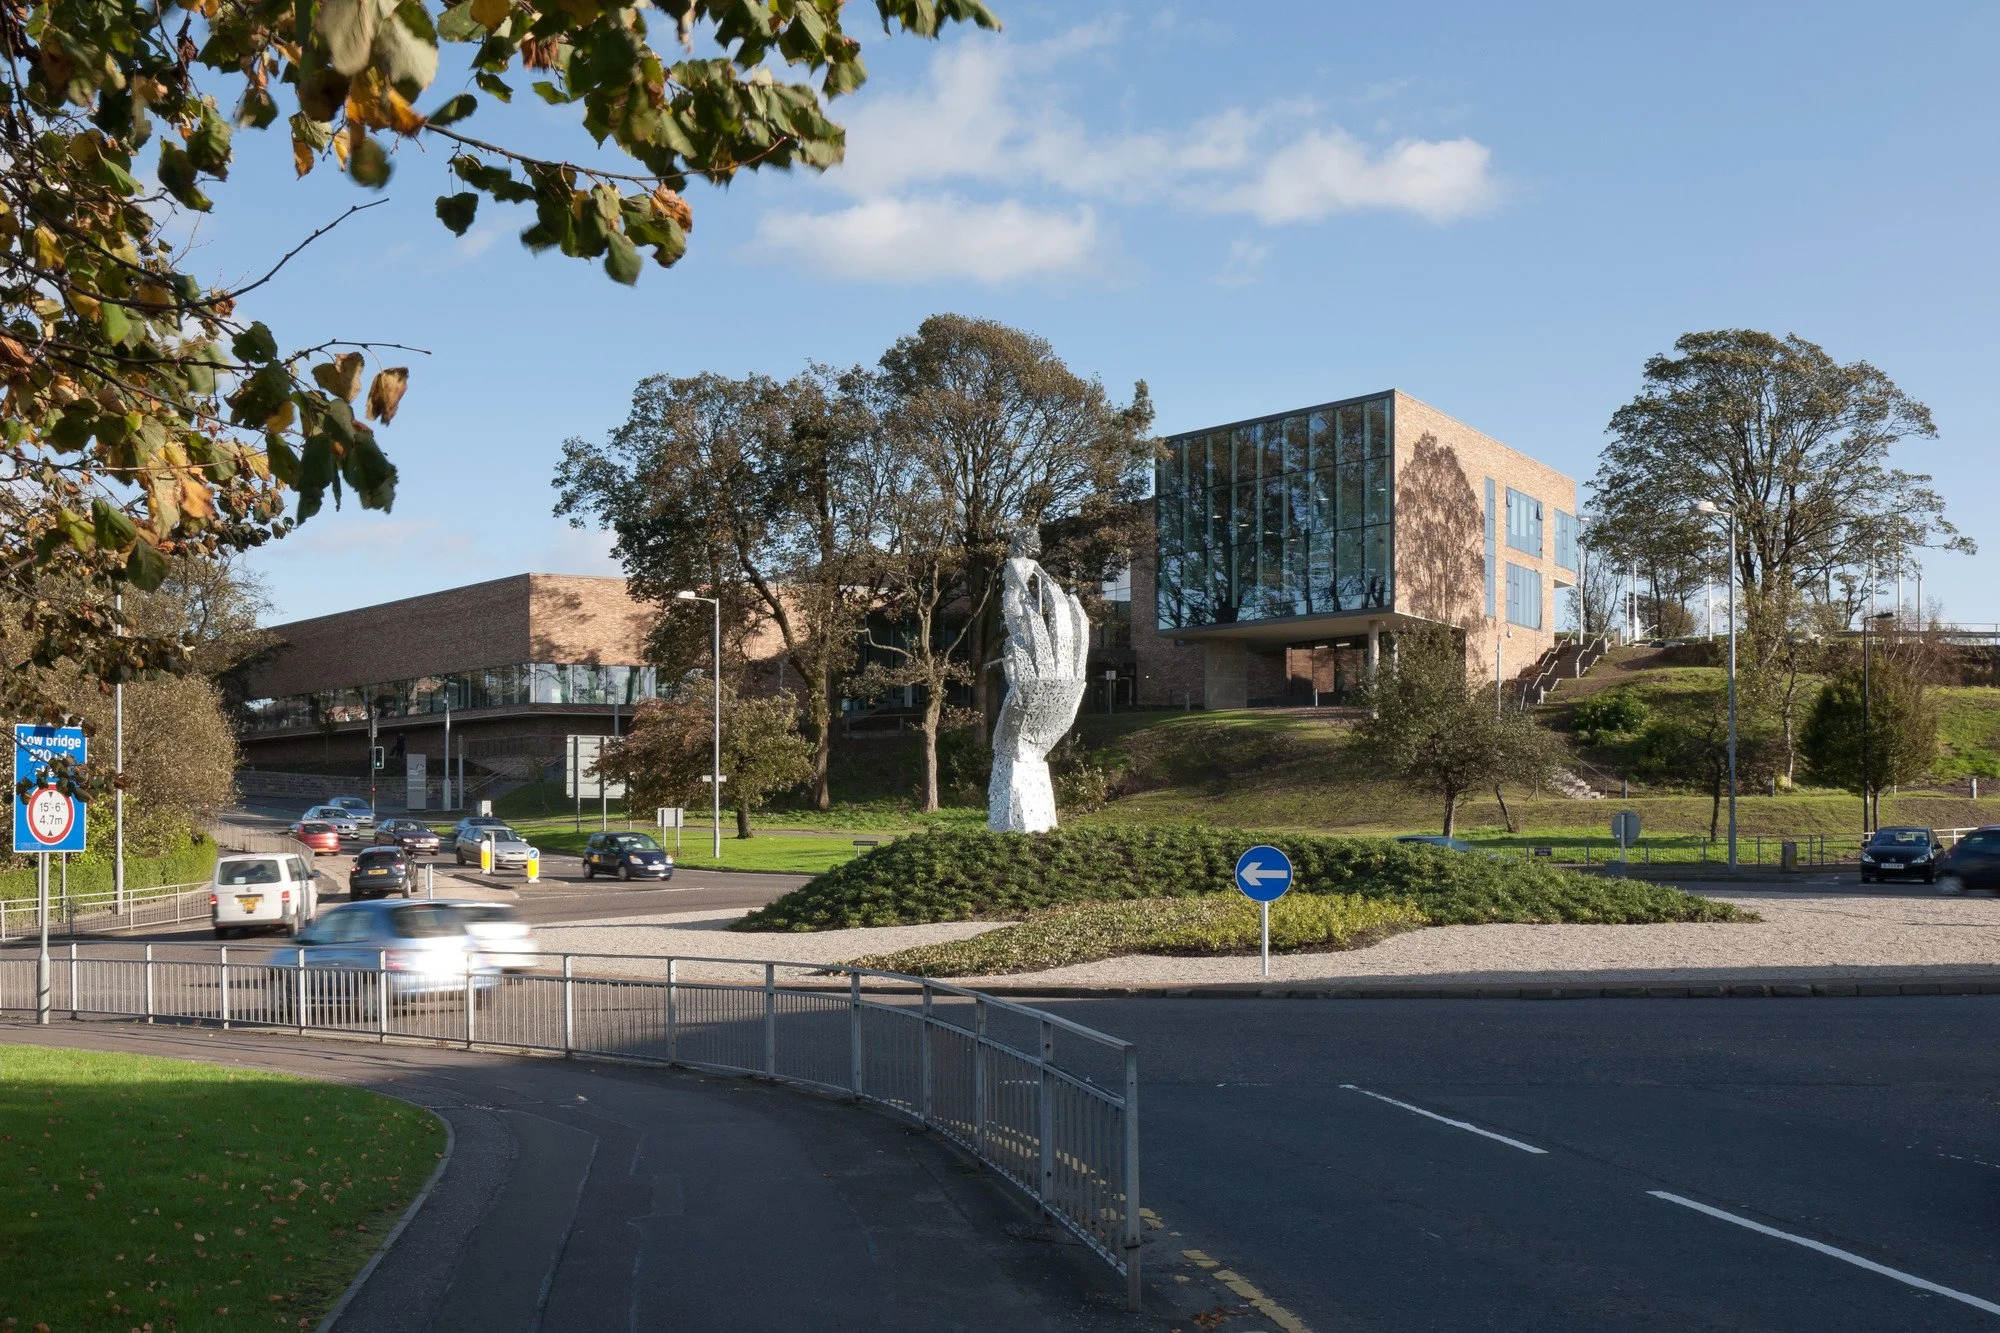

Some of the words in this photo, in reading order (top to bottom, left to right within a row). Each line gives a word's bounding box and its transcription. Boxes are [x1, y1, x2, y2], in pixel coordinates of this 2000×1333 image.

[20, 733, 43, 746] Low
[46, 734, 81, 750] bridge
[39, 815, 63, 825] 4.7m
